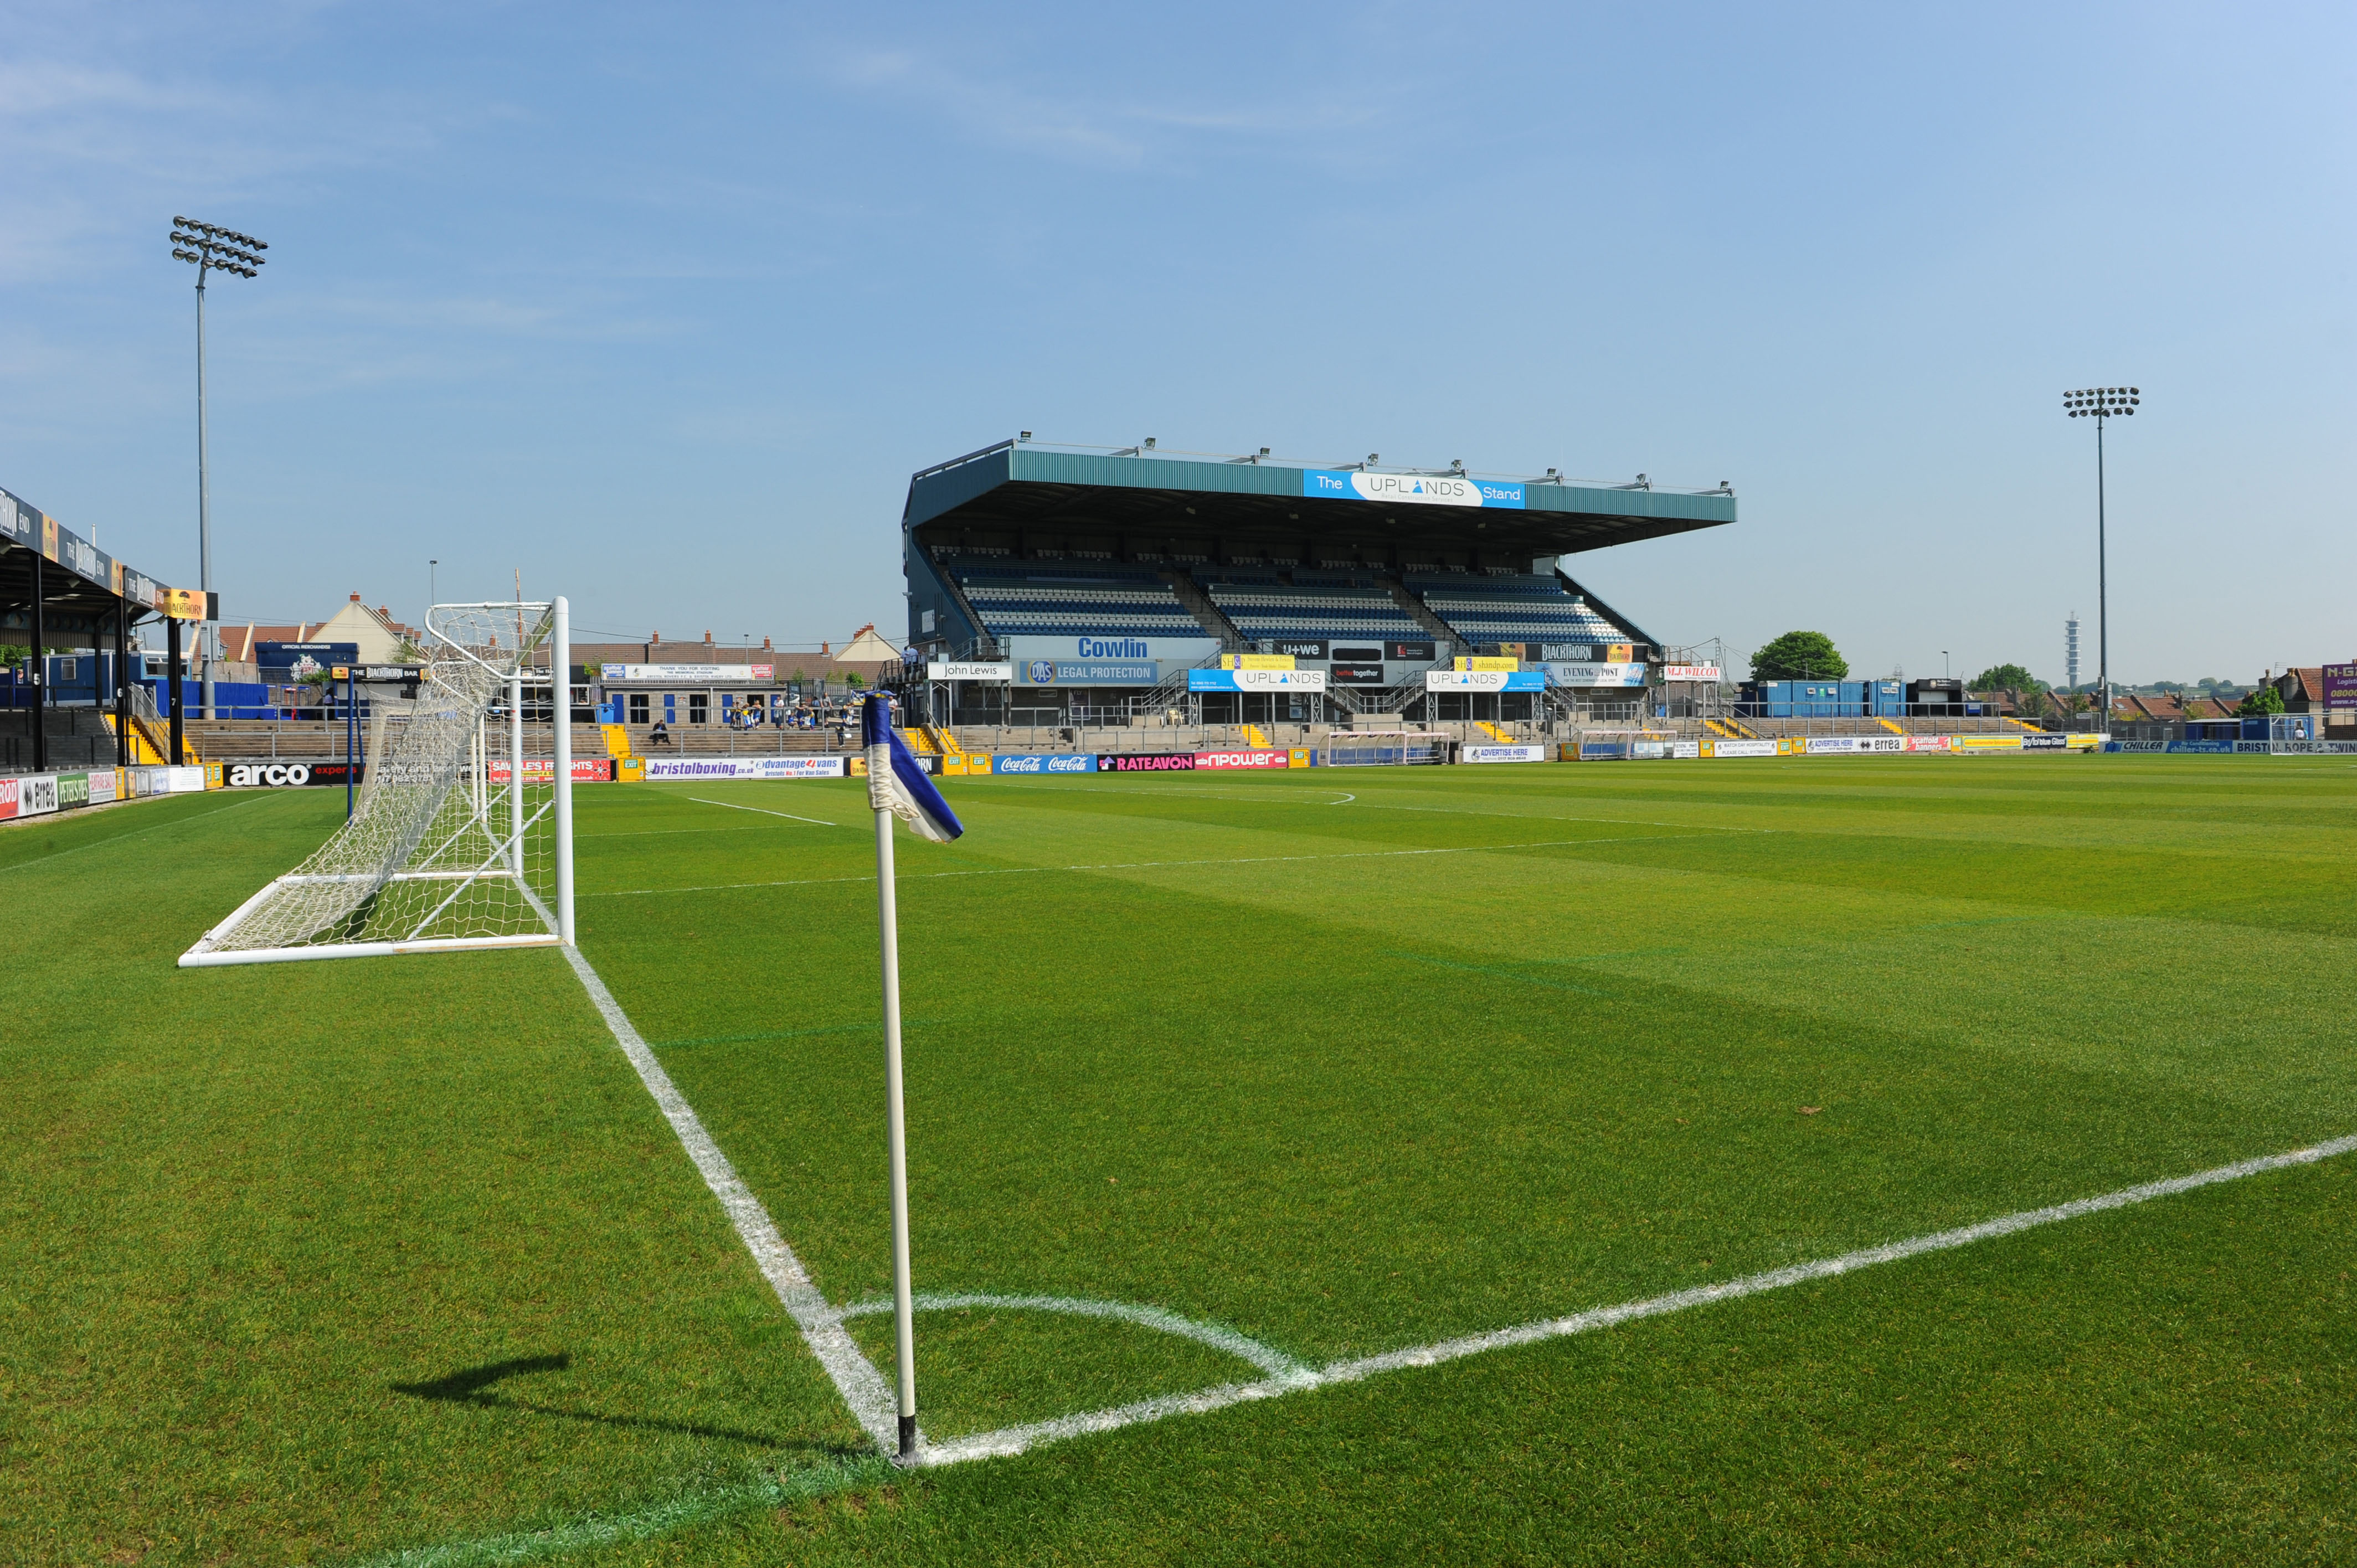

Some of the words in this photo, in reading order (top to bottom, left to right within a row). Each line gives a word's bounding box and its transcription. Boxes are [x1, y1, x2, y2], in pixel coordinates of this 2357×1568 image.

[1316, 476, 1343, 489] The
[1371, 478, 1464, 496] UPLANDS
[1483, 487, 1521, 500] Stand
[19, 513, 30, 534] END
[66, 542, 75, 560] THE
[128, 577, 137, 592] THE
[1078, 637, 1147, 658] Cowlin
[1542, 644, 1592, 661] BLACKTHORN
[944, 664, 967, 677] John
[970, 664, 997, 674] Lewis
[1032, 663, 1052, 681] DAS
[1058, 667, 1088, 678] LEGAL
[1090, 667, 1150, 678] PROTECTION
[1478, 660, 1515, 670] shandp.com
[1666, 667, 1683, 676] M.J.
[1685, 667, 1719, 677] WILCOX
[34, 673, 40, 685] 5
[367, 667, 403, 679] BLACKTHORN
[1246, 673, 1321, 684] UPLANDS
[1431, 674, 1497, 684] UPLANDS
[1563, 668, 1593, 677] EVENING
[1601, 668, 1619, 677] POST
[117, 688, 123, 698] 6
[1875, 740, 1900, 750] errea
[2124, 741, 2163, 750] CHILLER
[2285, 743, 2313, 752] ROPE
[2328, 743, 2357, 752] TWIN
[1001, 757, 1042, 772] Coca-Cola
[1048, 756, 1089, 771] Coca-Cola
[1116, 756, 1193, 771] RATEAVON
[1208, 753, 1274, 767] npower
[229, 764, 310, 786] arco
[315, 766, 357, 774] expers
[35, 782, 55, 809] errea
[59, 780, 78, 803] PETER'S
[79, 780, 88, 800] PIES
